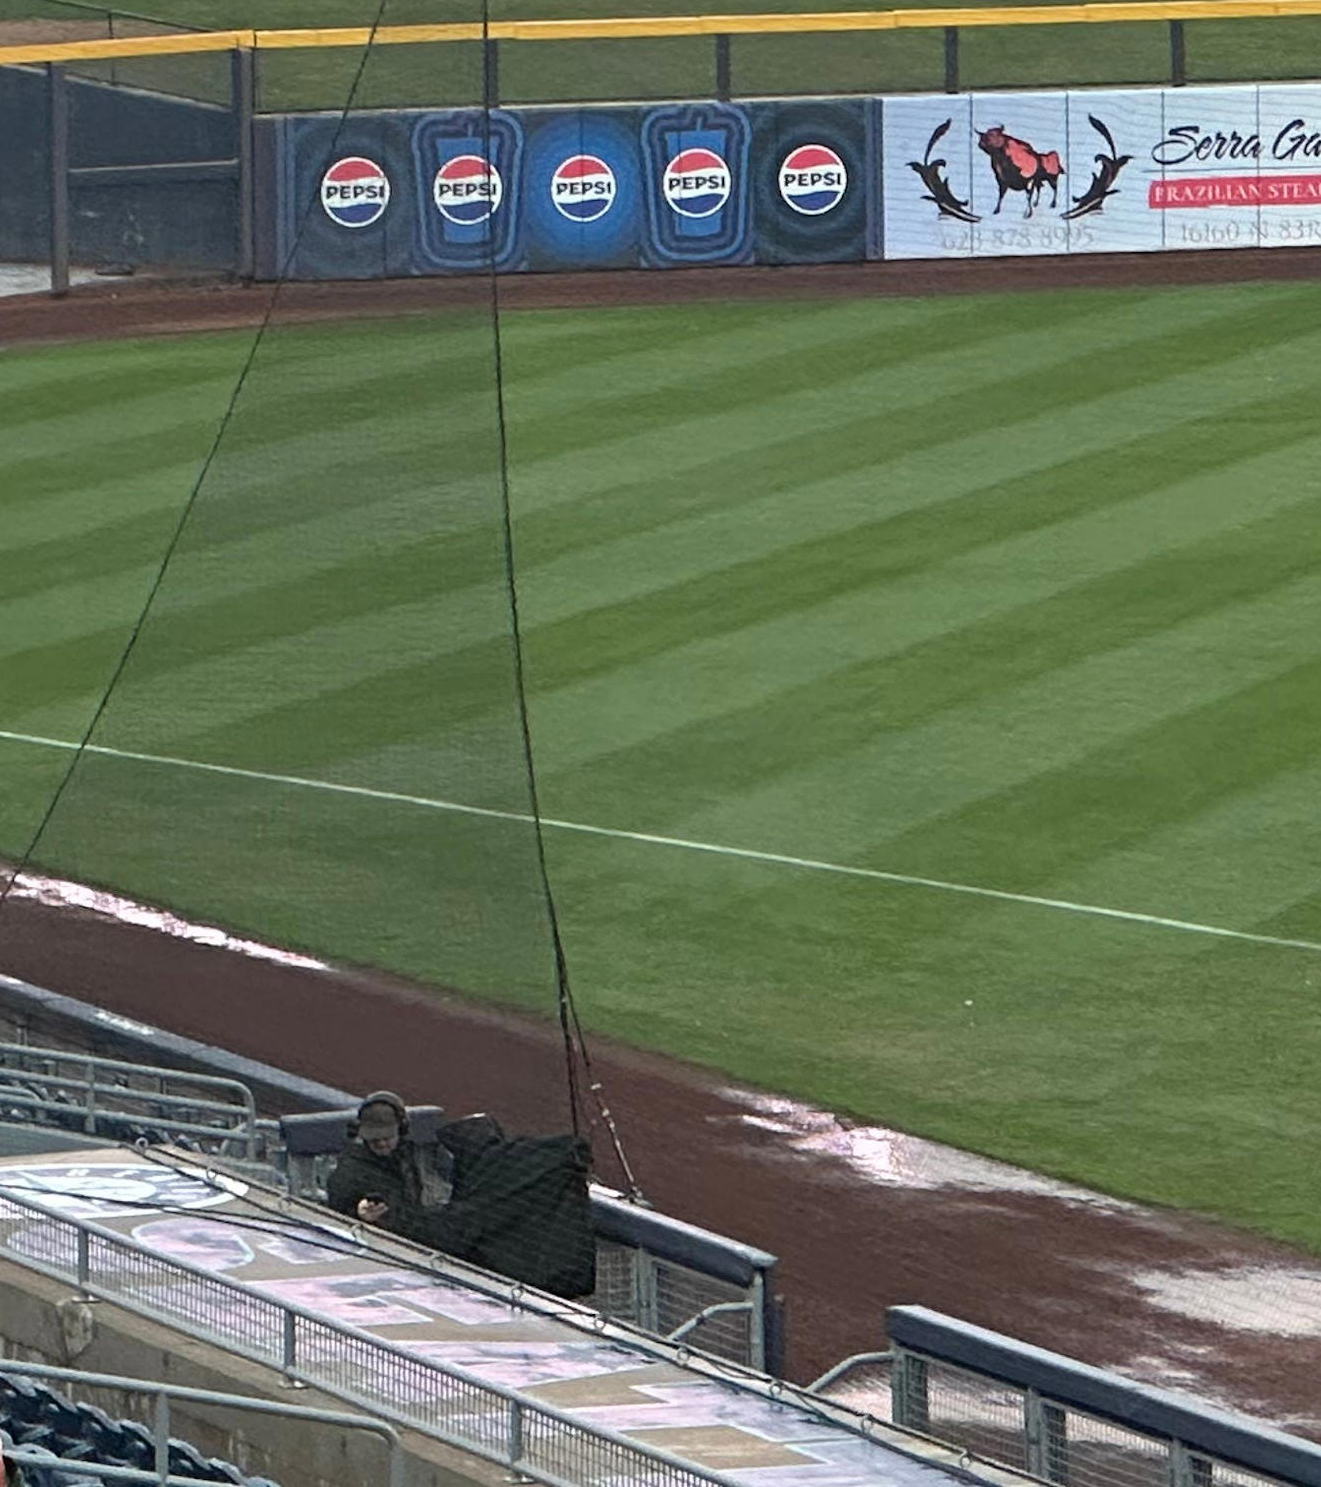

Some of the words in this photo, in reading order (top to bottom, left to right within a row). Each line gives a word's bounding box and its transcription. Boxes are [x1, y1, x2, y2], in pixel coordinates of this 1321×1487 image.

[1151, 125, 1261, 165] Serra
[556, 181, 612, 196] PEPSI
[668, 175, 726, 190] PEPSI
[783, 173, 842, 189] PEPSI
[326, 185, 384, 200] PEPSI
[438, 182, 498, 197] PEPSI
